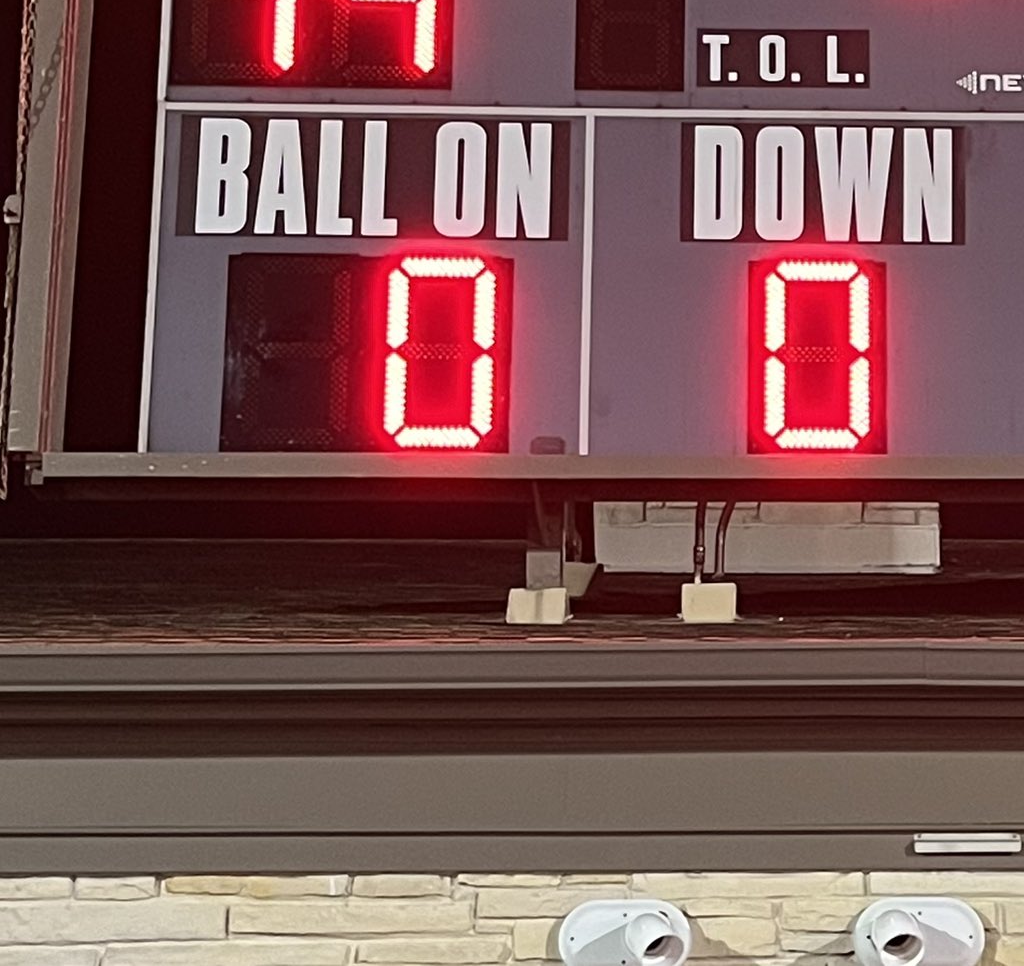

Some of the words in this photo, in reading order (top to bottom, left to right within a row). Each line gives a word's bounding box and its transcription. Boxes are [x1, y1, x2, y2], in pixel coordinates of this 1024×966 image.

[194, 117, 399, 237] BALL
[432, 120, 552, 240] ON
[692, 124, 954, 244] DOWN
[382, 255, 497, 450] 0
[763, 259, 872, 450] 0
